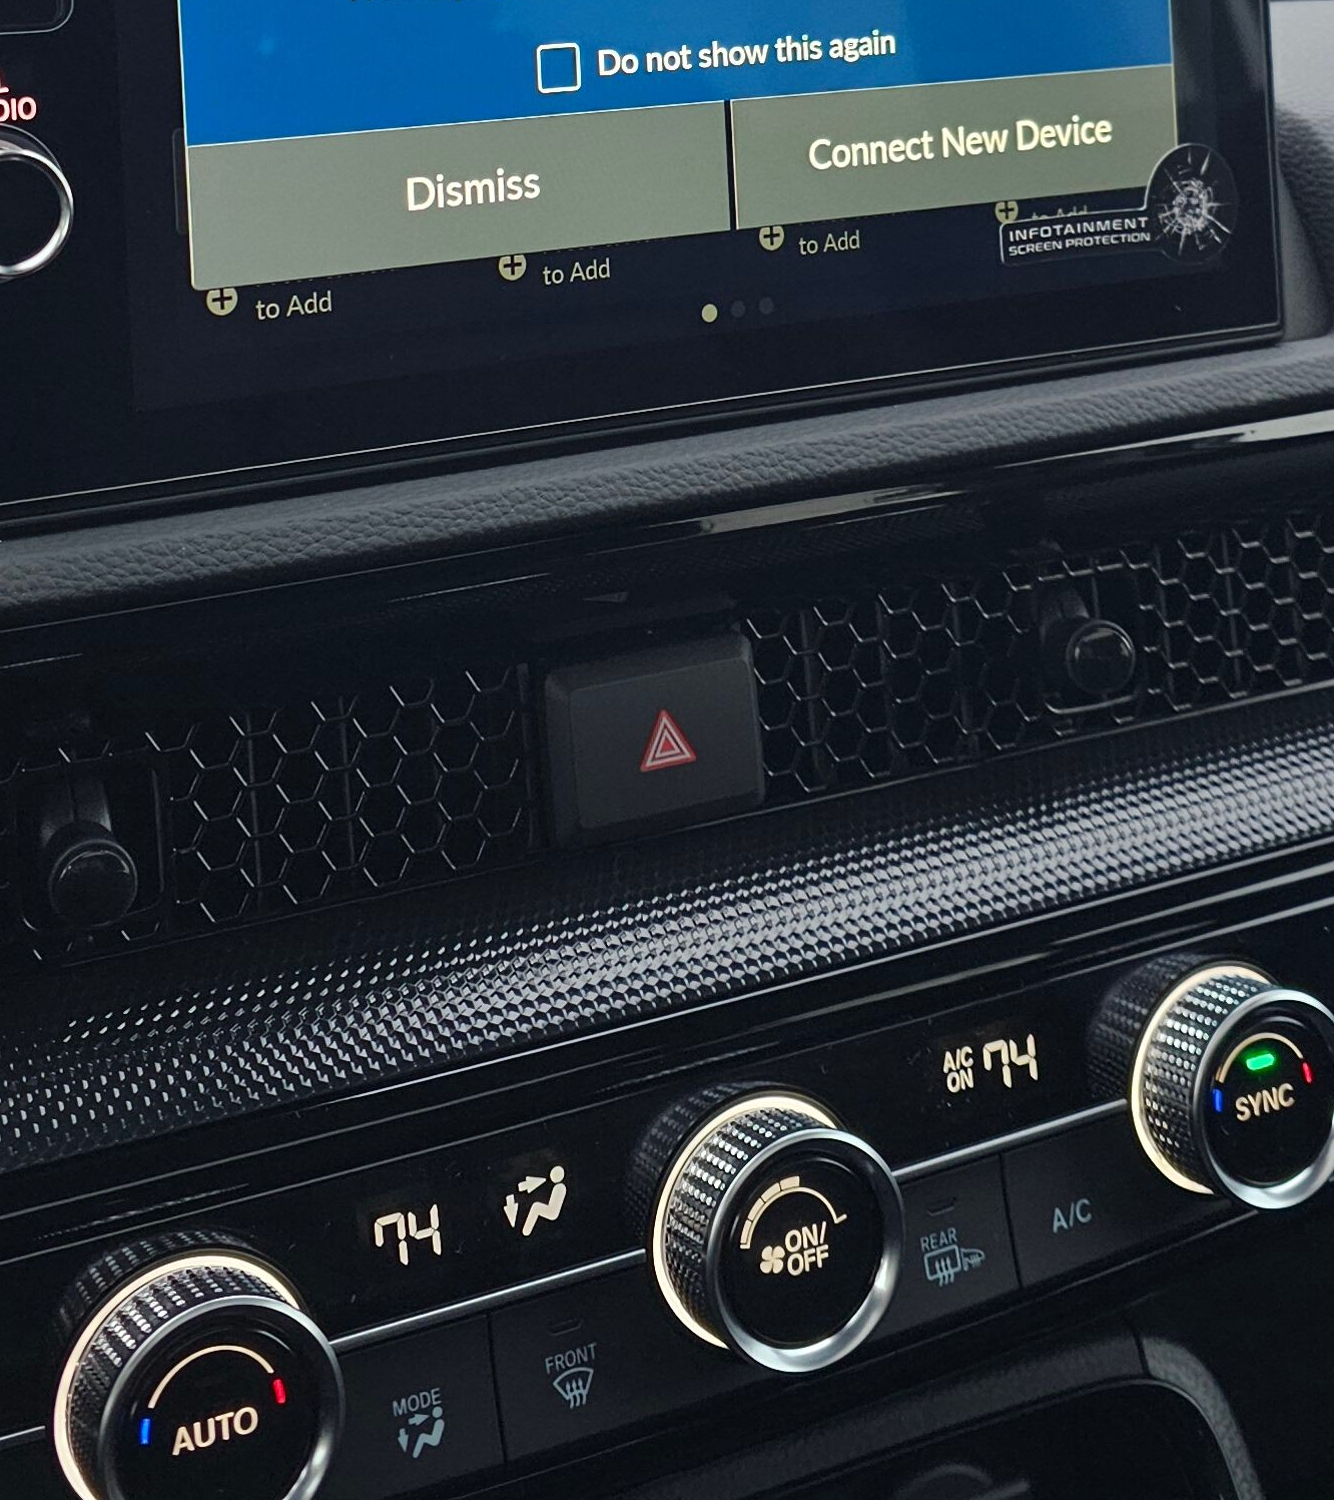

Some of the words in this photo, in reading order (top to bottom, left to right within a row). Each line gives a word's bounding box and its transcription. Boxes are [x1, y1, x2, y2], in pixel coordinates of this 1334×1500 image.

[597, 49, 639, 77] Do
[646, 45, 693, 73] not
[699, 41, 769, 70] show
[774, 35, 823, 63] this
[829, 30, 896, 63] again
[808, 130, 935, 170] Connect
[941, 125, 1009, 159] New
[1016, 114, 1112, 151] Device
[407, 167, 541, 212] Dismiss
[799, 237, 819, 256] to
[823, 229, 860, 253] Add
[1008, 241, 1063, 257] SCREEN
[1064, 232, 1151, 249] PROTECTION
[1009, 216, 1150, 242] INFOTAINMENT
[542, 266, 565, 286] to
[570, 257, 611, 283] Add
[256, 300, 280, 320] to
[287, 291, 332, 317] Add
[944, 1046, 974, 1072] A/C
[982, 1034, 1039, 1089] 74
[946, 1066, 974, 1092] ON
[1234, 1083, 1295, 1121] SYNC
[1052, 1198, 1092, 1233] A/C
[374, 1203, 442, 1266] 74
[784, 1224, 827, 1250] ON/
[921, 1227, 957, 1252] REAR
[786, 1243, 829, 1277] OFF
[544, 1343, 596, 1375] FRONT
[392, 1387, 443, 1417] MODE
[172, 1406, 259, 1456] AUTO
